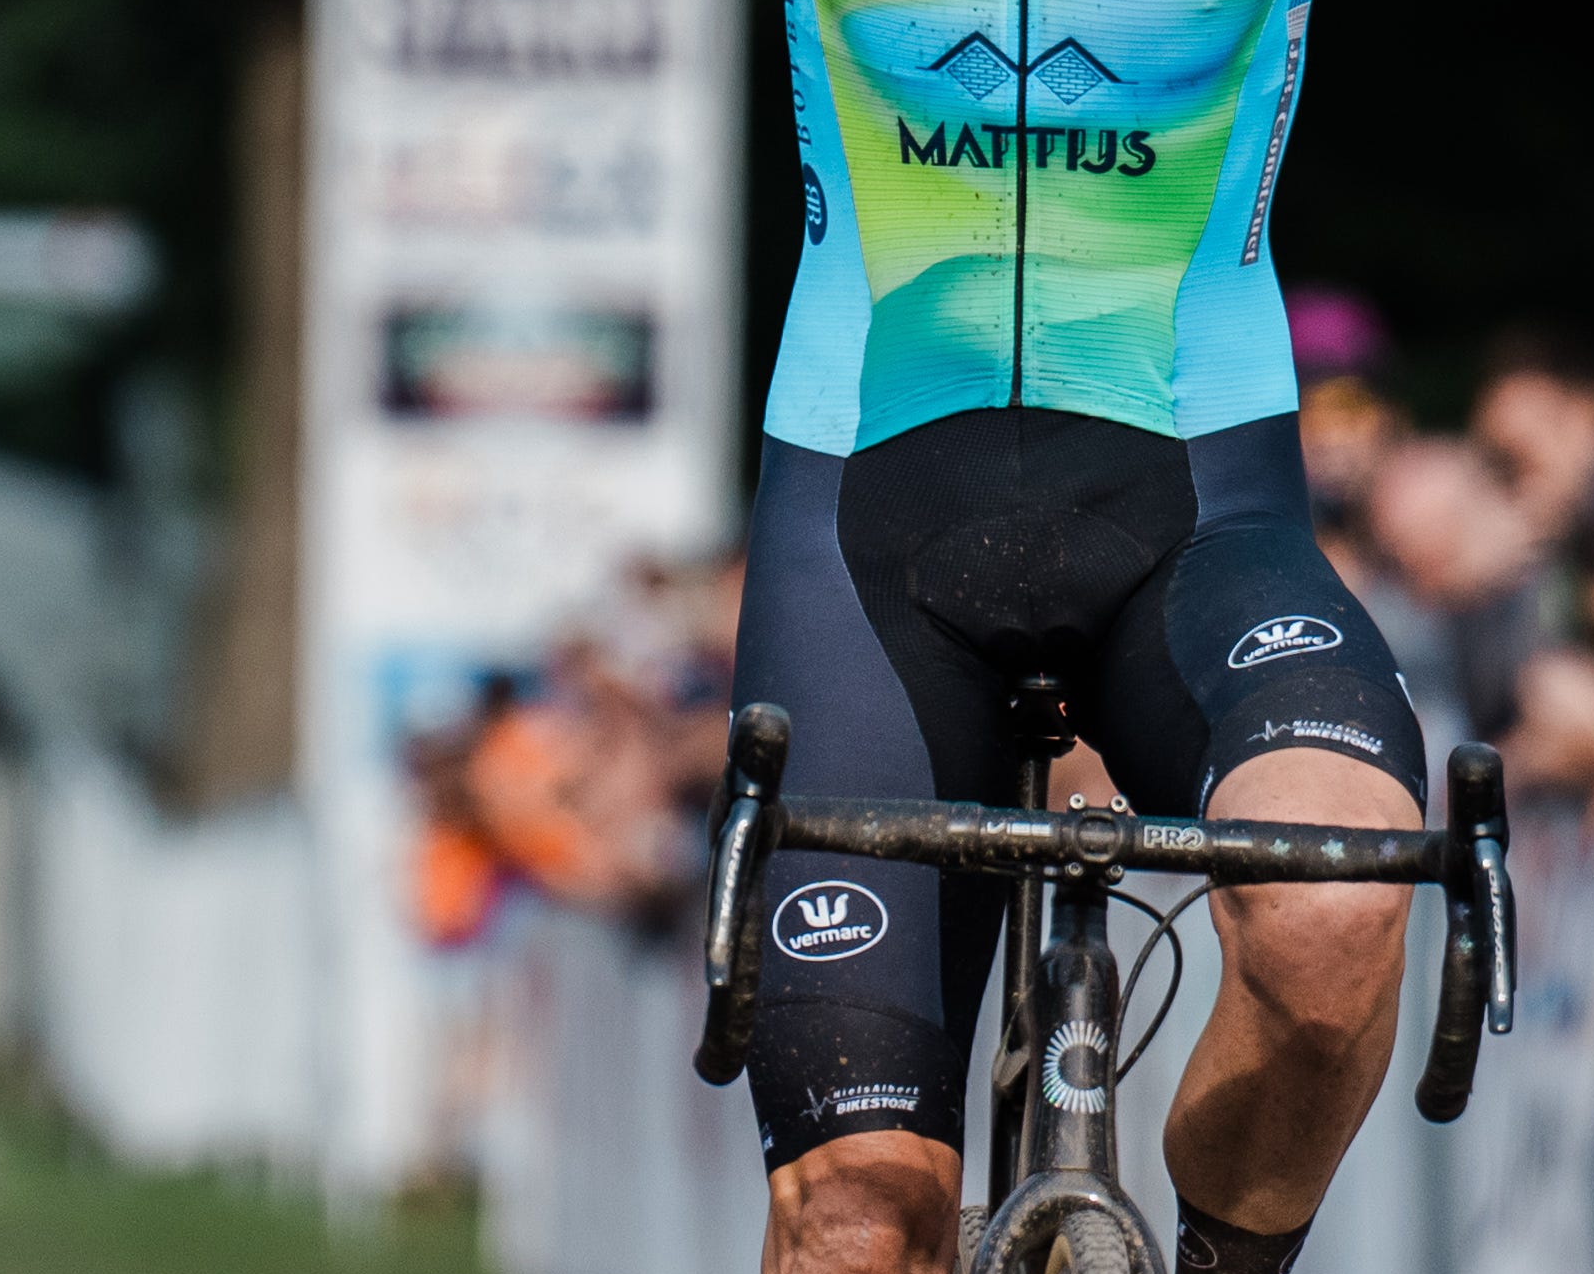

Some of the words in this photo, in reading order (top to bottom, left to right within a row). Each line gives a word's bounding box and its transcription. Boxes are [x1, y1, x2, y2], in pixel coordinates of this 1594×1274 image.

[897, 116, 1157, 177] MATTIJS
[1243, 111, 1287, 264] Construct
[1243, 635, 1325, 663] vermarc
[1143, 824, 1206, 851] PRO
[789, 925, 872, 950] vermarc
[836, 1097, 917, 1115] BIKESTORE
